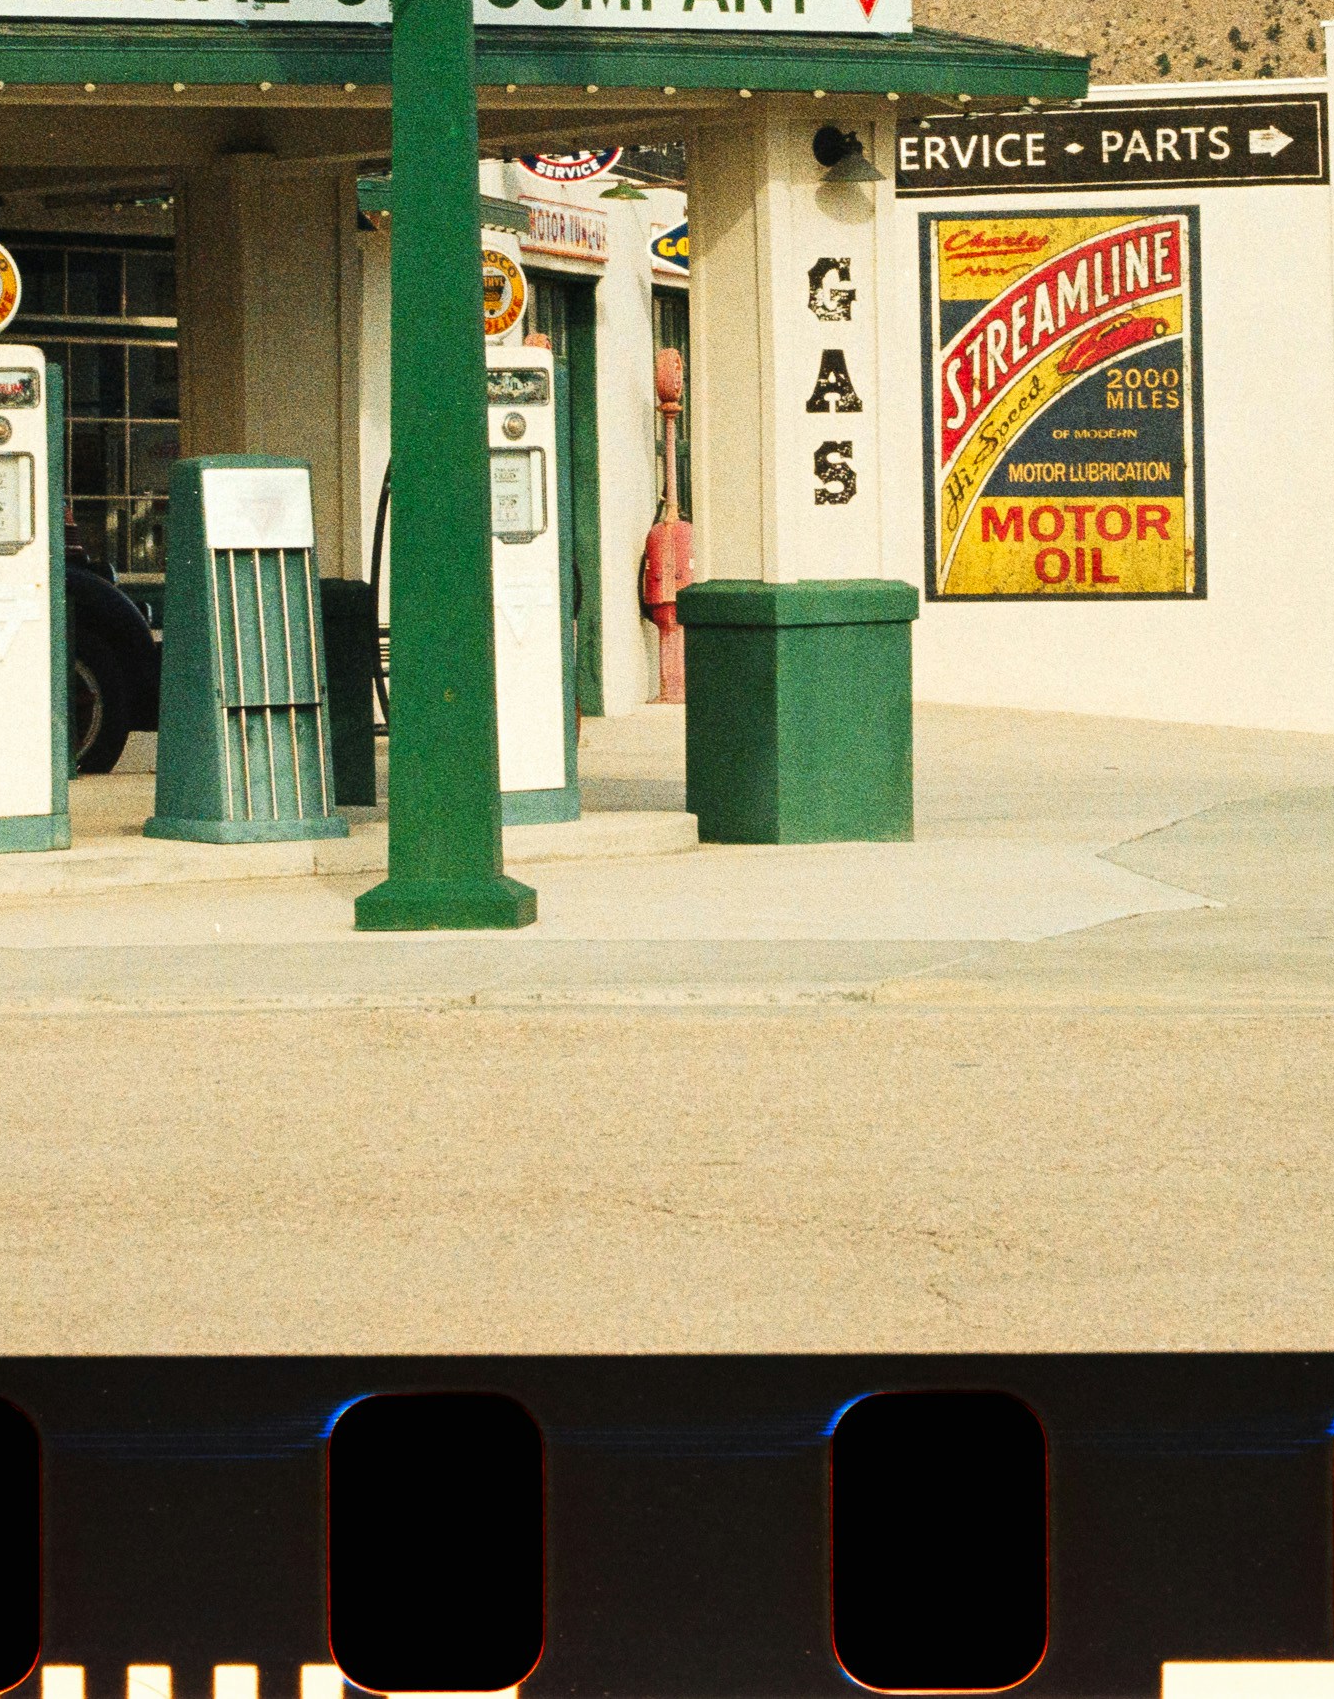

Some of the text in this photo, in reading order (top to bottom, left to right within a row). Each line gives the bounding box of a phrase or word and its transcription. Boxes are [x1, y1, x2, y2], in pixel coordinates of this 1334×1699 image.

[900, 126, 1230, 171] ERVICE PARTS
[534, 158, 601, 179] SERVICE
[529, 208, 566, 245] MOTOR
[946, 230, 1174, 430] STREAMLINE
[805, 257, 864, 506] GAS
[1106, 368, 1180, 390] 2000
[1106, 391, 1181, 410] MILES
[1052, 429, 1138, 440] OF MODERN
[947, 375, 1045, 532] Hi-Speed
[1008, 462, 1170, 483] MOTOR LUBRICATION
[981, 504, 1171, 543] MOTOR
[1034, 547, 1120, 584] OIL
